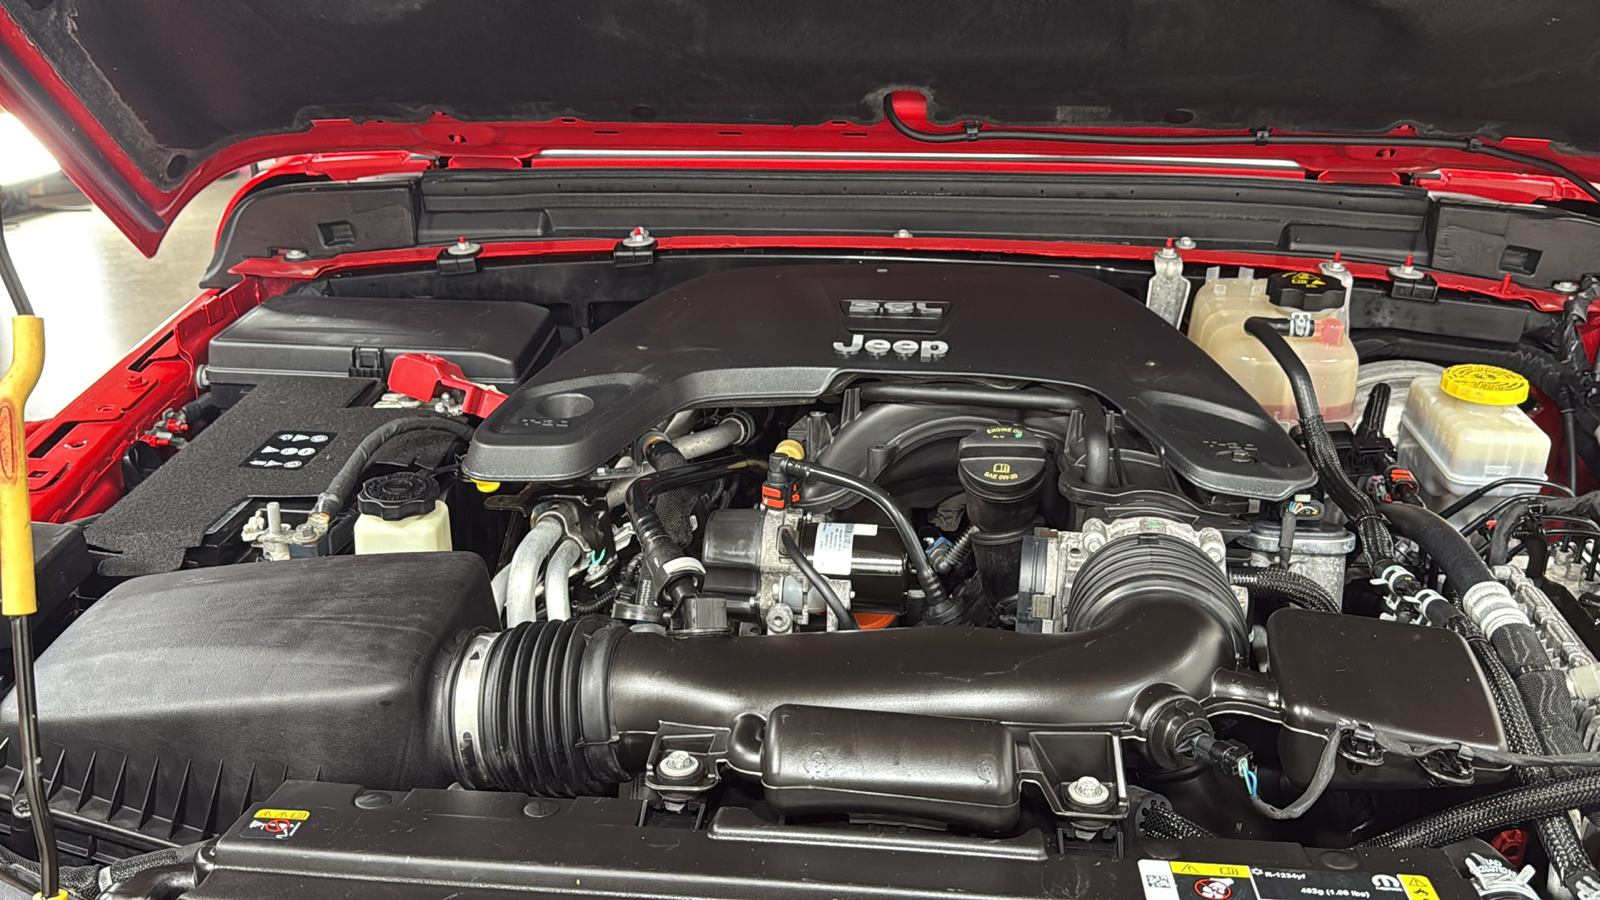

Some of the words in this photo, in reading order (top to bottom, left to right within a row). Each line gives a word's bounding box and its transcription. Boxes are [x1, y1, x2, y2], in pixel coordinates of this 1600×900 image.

[832, 334, 949, 361] Jeep
[983, 471, 998, 480] SAE
[998, 472, 1019, 480] 0W-20
